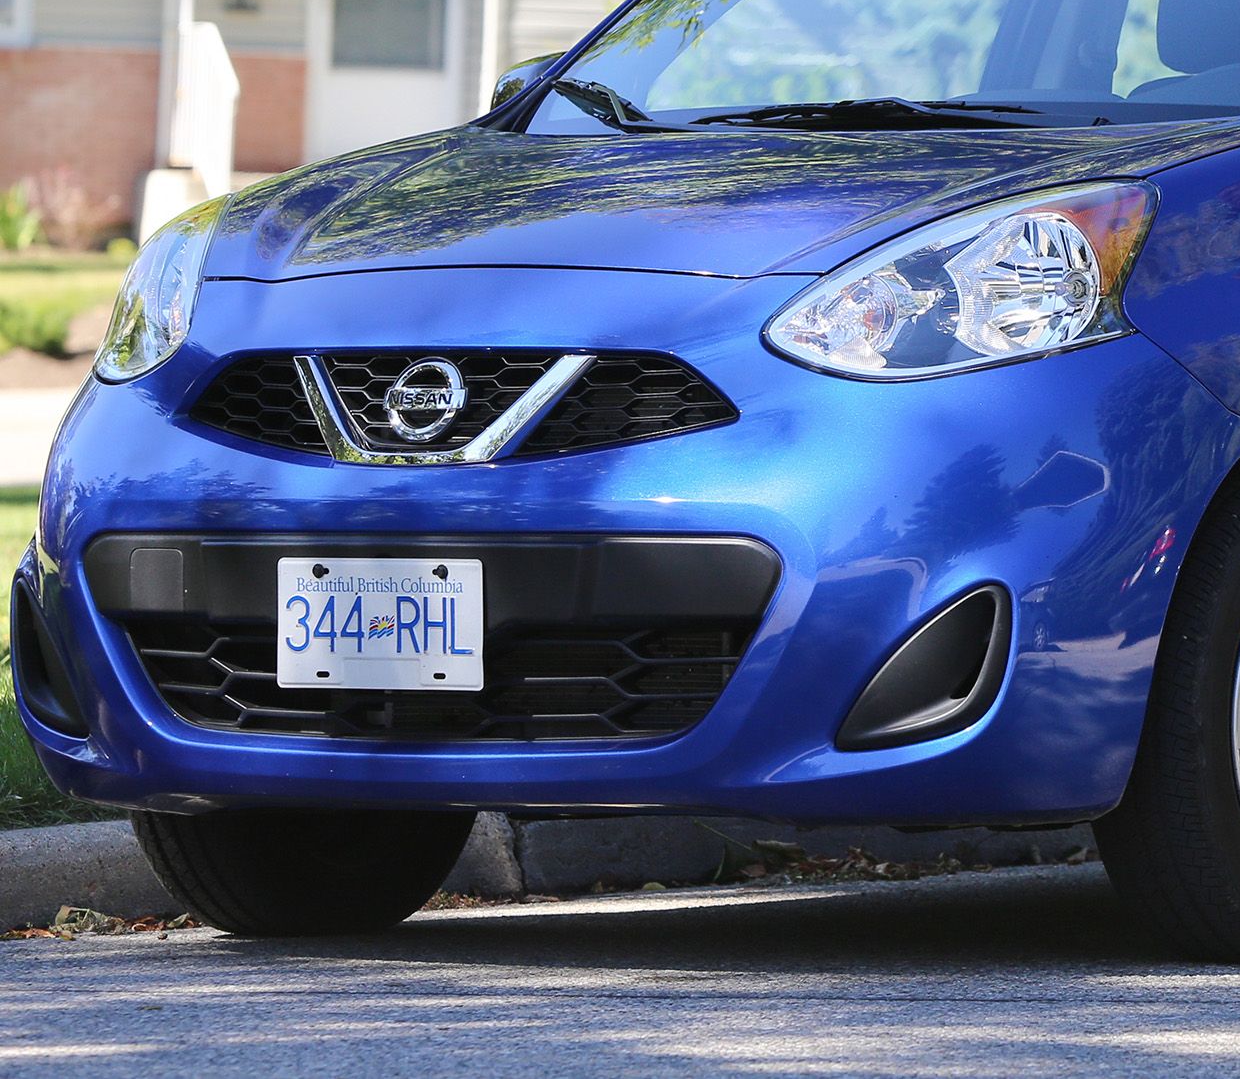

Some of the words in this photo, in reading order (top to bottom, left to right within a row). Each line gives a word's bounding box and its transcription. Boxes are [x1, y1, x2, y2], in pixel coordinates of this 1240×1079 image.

[389, 392, 453, 406] NISSAN
[296, 577, 354, 593] Beautiful
[358, 578, 398, 593] British
[401, 578, 463, 594] Columbia
[286, 595, 365, 653] 344
[396, 596, 474, 654] RHL
